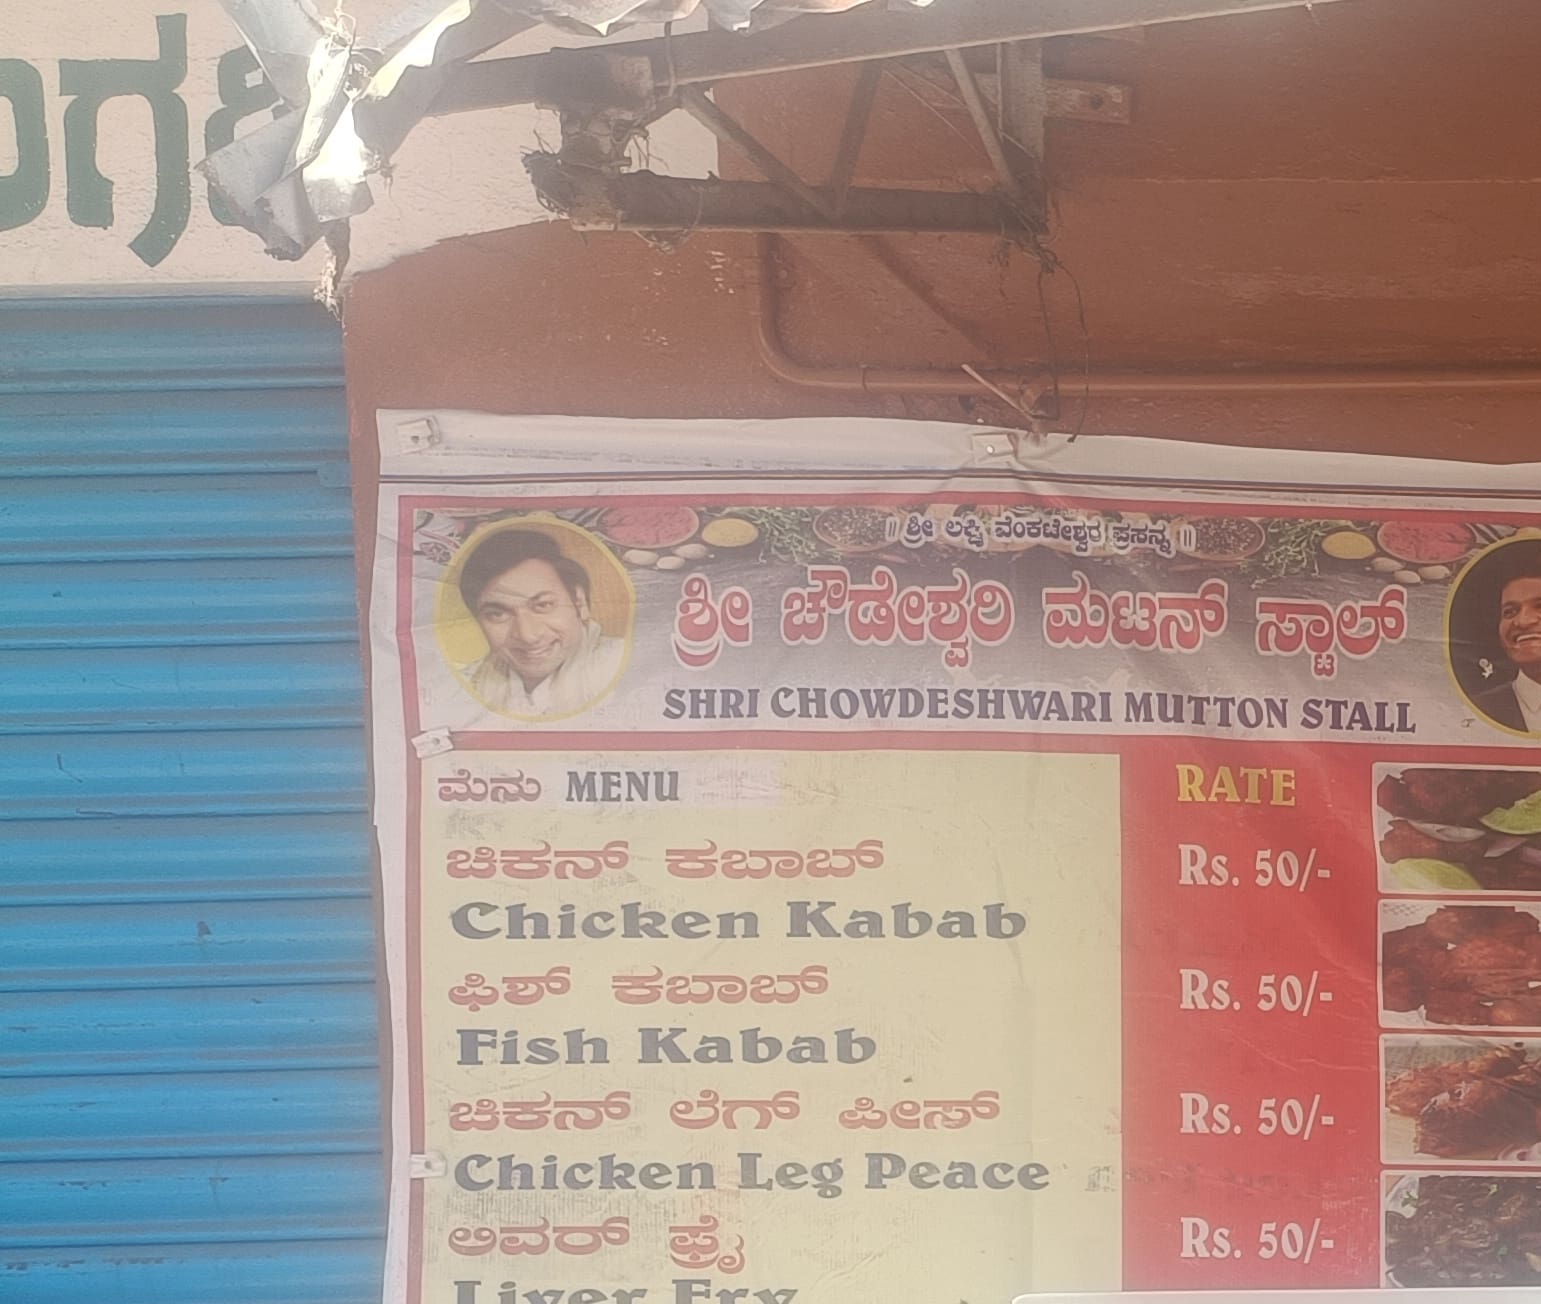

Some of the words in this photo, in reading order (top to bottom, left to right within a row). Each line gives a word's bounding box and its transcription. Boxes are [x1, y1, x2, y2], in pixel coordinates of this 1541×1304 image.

[903, 515, 934, 544] ಶ್ರೀ
[994, 514, 1102, 553] ವೆಂಕಟೇಶ್ವರ
[1111, 522, 1172, 556] ಪ್ರಸನ್ನ
[674, 576, 750, 668] ಶ್ರೀ
[782, 569, 1013, 668] ಚೌಡೇಶ್ವರಿ
[1044, 573, 1226, 650] ಮಟನ್
[1257, 588, 1406, 678] ಸ್ಟಾಲ್
[661, 687, 761, 720] SHRI
[769, 686, 1112, 723] CHOWDESHWARI
[1123, 690, 1289, 730] MUTTON
[1299, 698, 1417, 734] STALL
[437, 768, 542, 802] ಮೆನು
[565, 770, 680, 802] MENU
[1175, 764, 1297, 807] RATE
[446, 838, 630, 880] ಚಿಕನ್
[665, 838, 885, 880] ಕಬಾಬ್
[1178, 843, 1240, 887] Rs.
[1254, 847, 1332, 893] 50/-
[451, 901, 760, 940] Chicken
[786, 900, 1027, 940] Kabab
[447, 966, 572, 1012] ಫಿಶ್
[611, 965, 829, 1005] ಕಬಾಬ್
[1178, 967, 1241, 1010] Rs.
[1257, 970, 1334, 1016] 50/-
[456, 1028, 610, 1066] Fish
[637, 1026, 877, 1065] Kabab
[449, 1090, 632, 1131] ಚಿಕನ್
[669, 1089, 801, 1131] ಲೆಗ್
[838, 1089, 1001, 1130] ಪೀಸ್
[1179, 1092, 1242, 1135] Rs.
[1258, 1093, 1335, 1140] 50/-
[454, 1153, 717, 1192] Chicken
[736, 1152, 844, 1199] Leg
[864, 1152, 1050, 1191] Peace
[447, 1216, 630, 1256] ಲಿವರ್
[669, 1214, 746, 1275] ಫ್ರೈ
[1179, 1216, 1242, 1259] Rs.
[1258, 1217, 1335, 1264] 50/-
